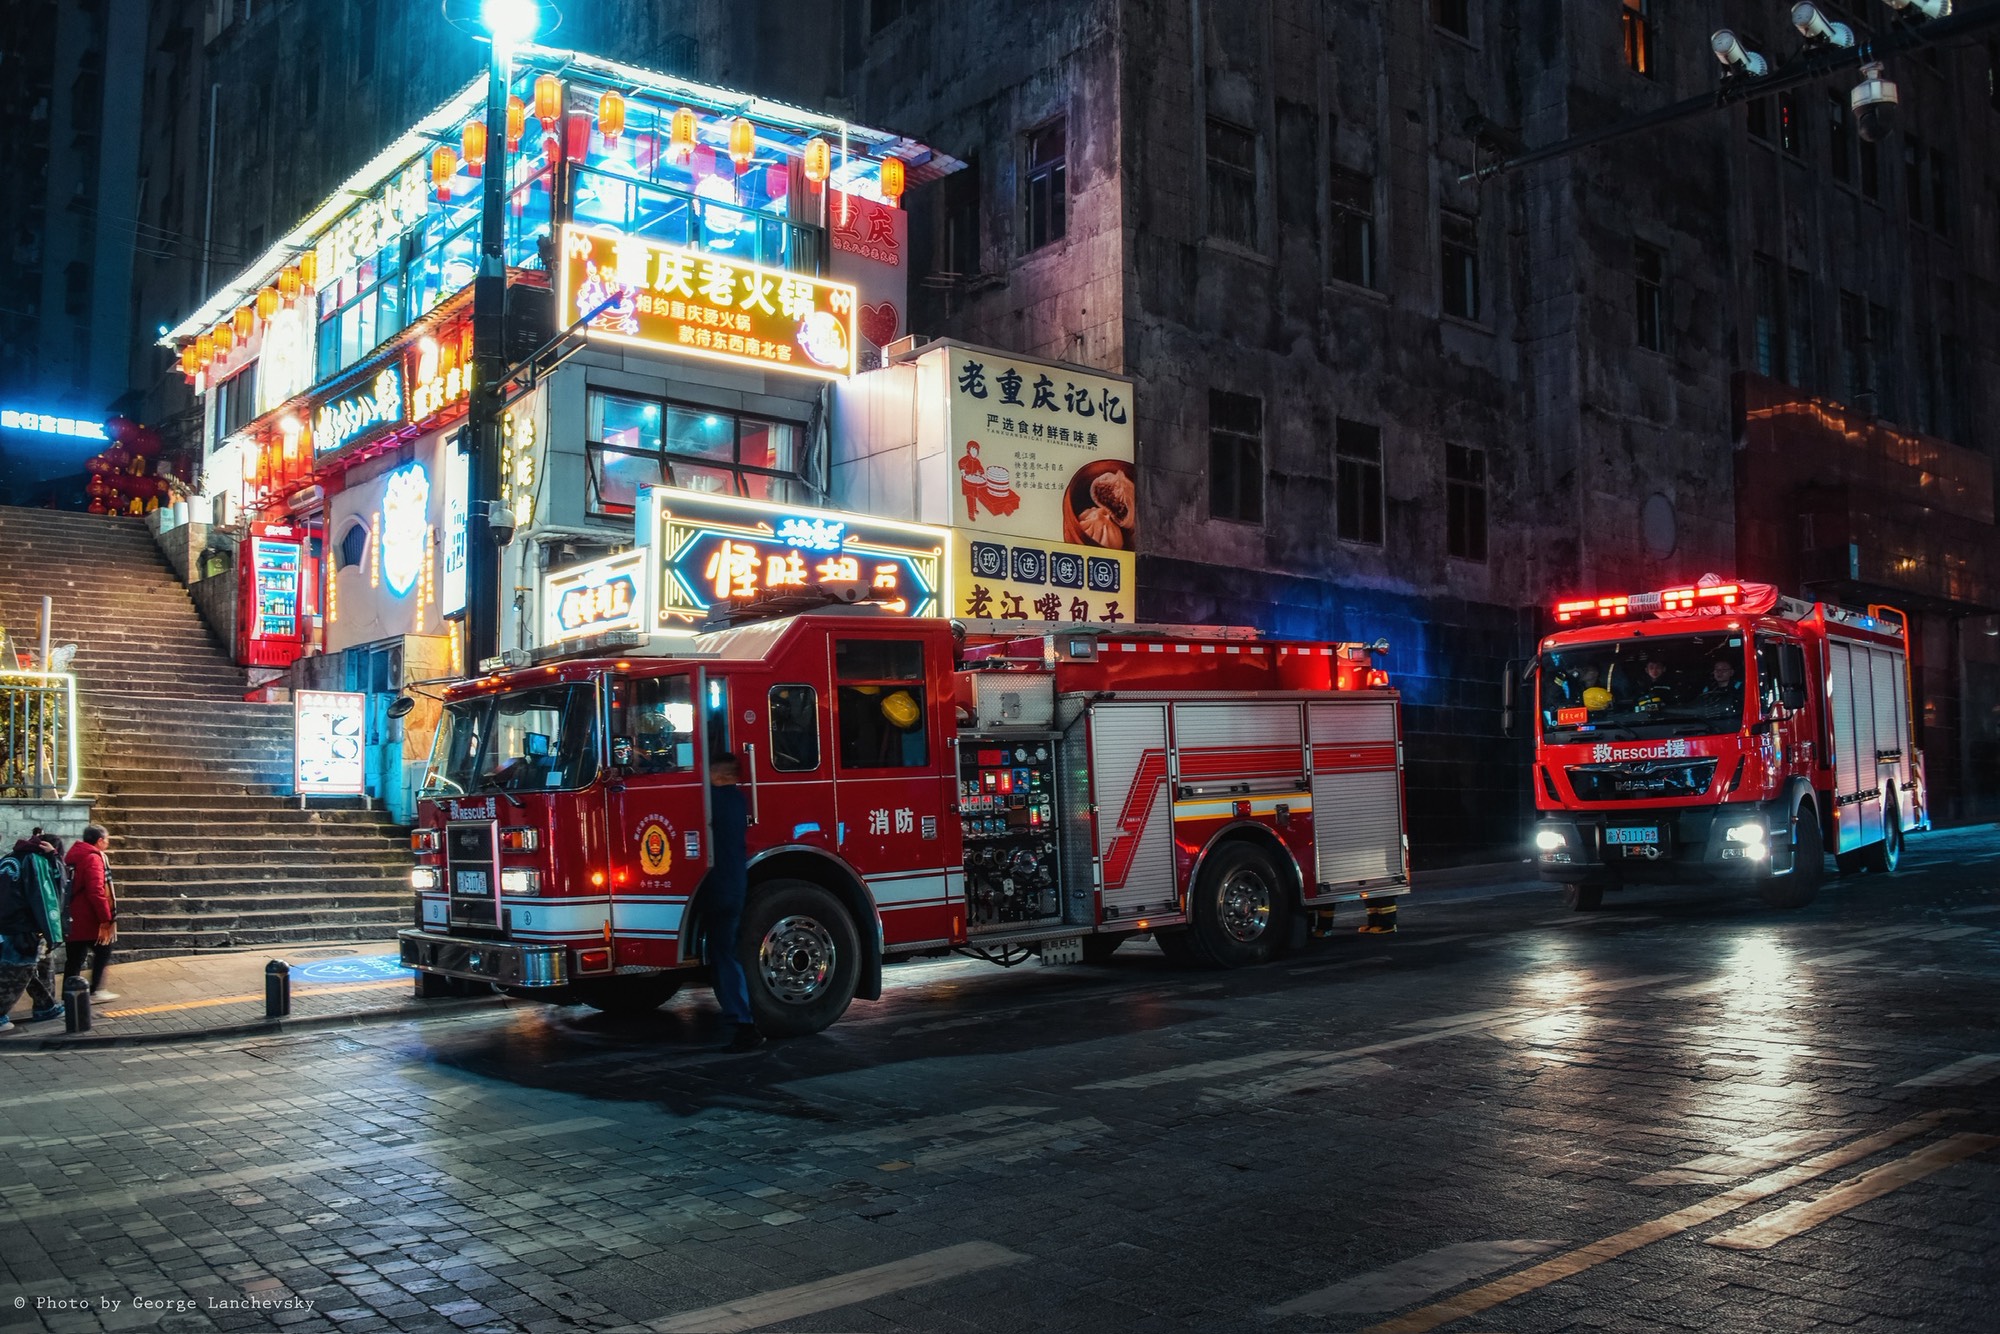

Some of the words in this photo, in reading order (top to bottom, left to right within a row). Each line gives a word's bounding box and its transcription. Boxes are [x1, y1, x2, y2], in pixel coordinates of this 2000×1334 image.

[614, 242, 816, 321] 重庆老火锅
[679, 324, 793, 363] 款待东西南北客
[958, 359, 1127, 425] 老重庆记忆
[868, 807, 914, 836] 消防
